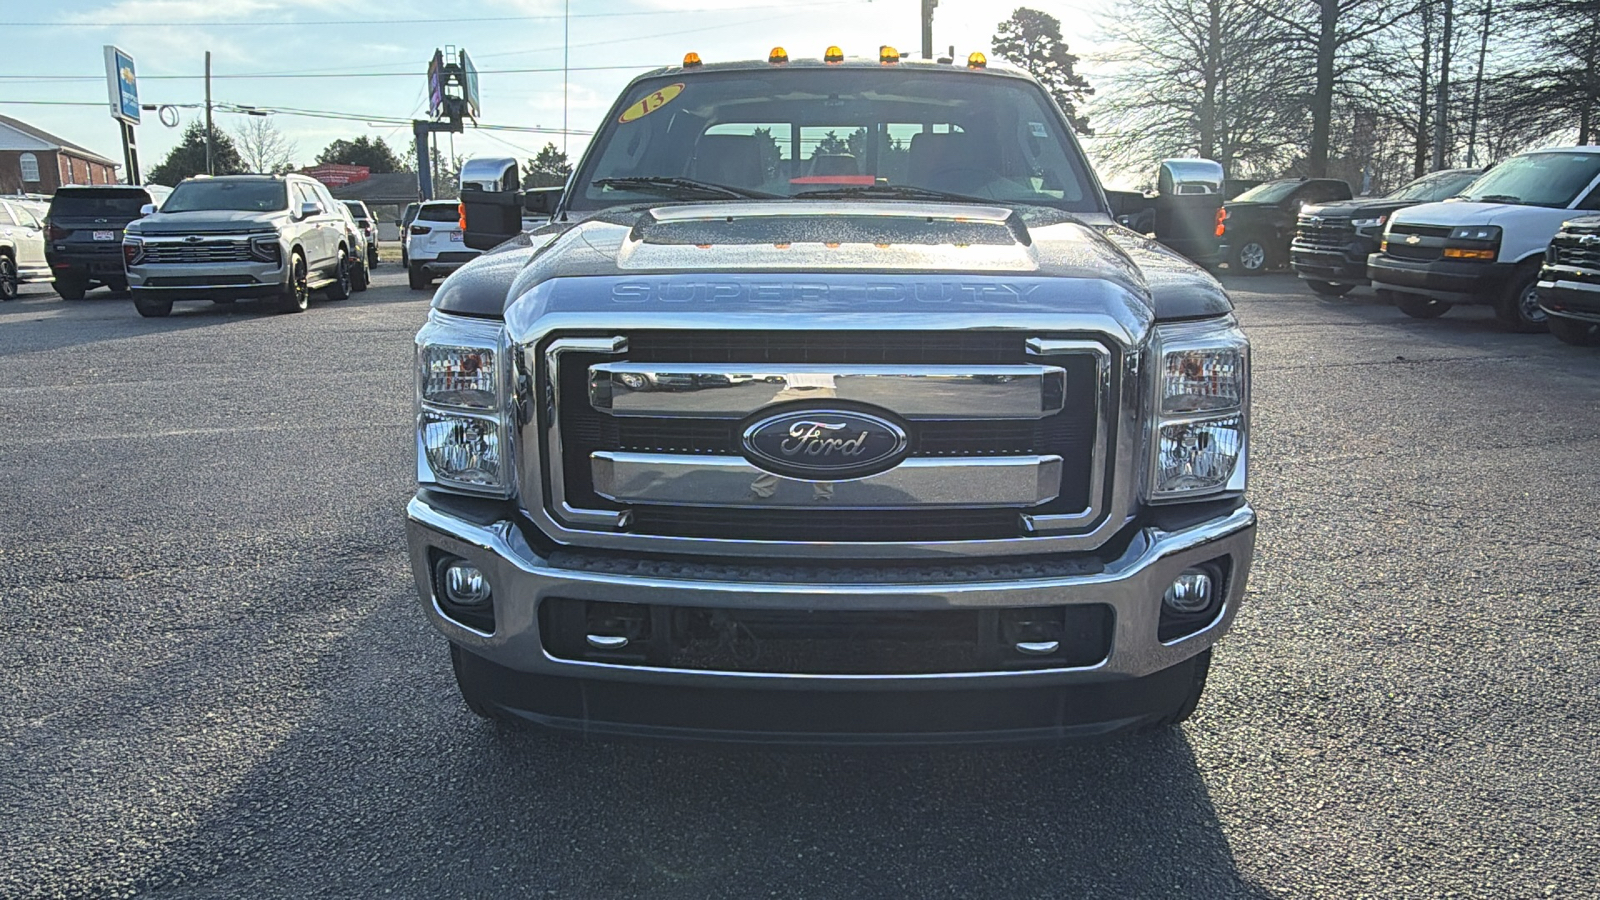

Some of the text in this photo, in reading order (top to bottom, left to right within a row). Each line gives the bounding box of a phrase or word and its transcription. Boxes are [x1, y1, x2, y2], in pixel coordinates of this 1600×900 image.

[641, 91, 665, 114] 13
[611, 281, 1041, 303] SUPER DUTY
[781, 420, 869, 456] Ford
